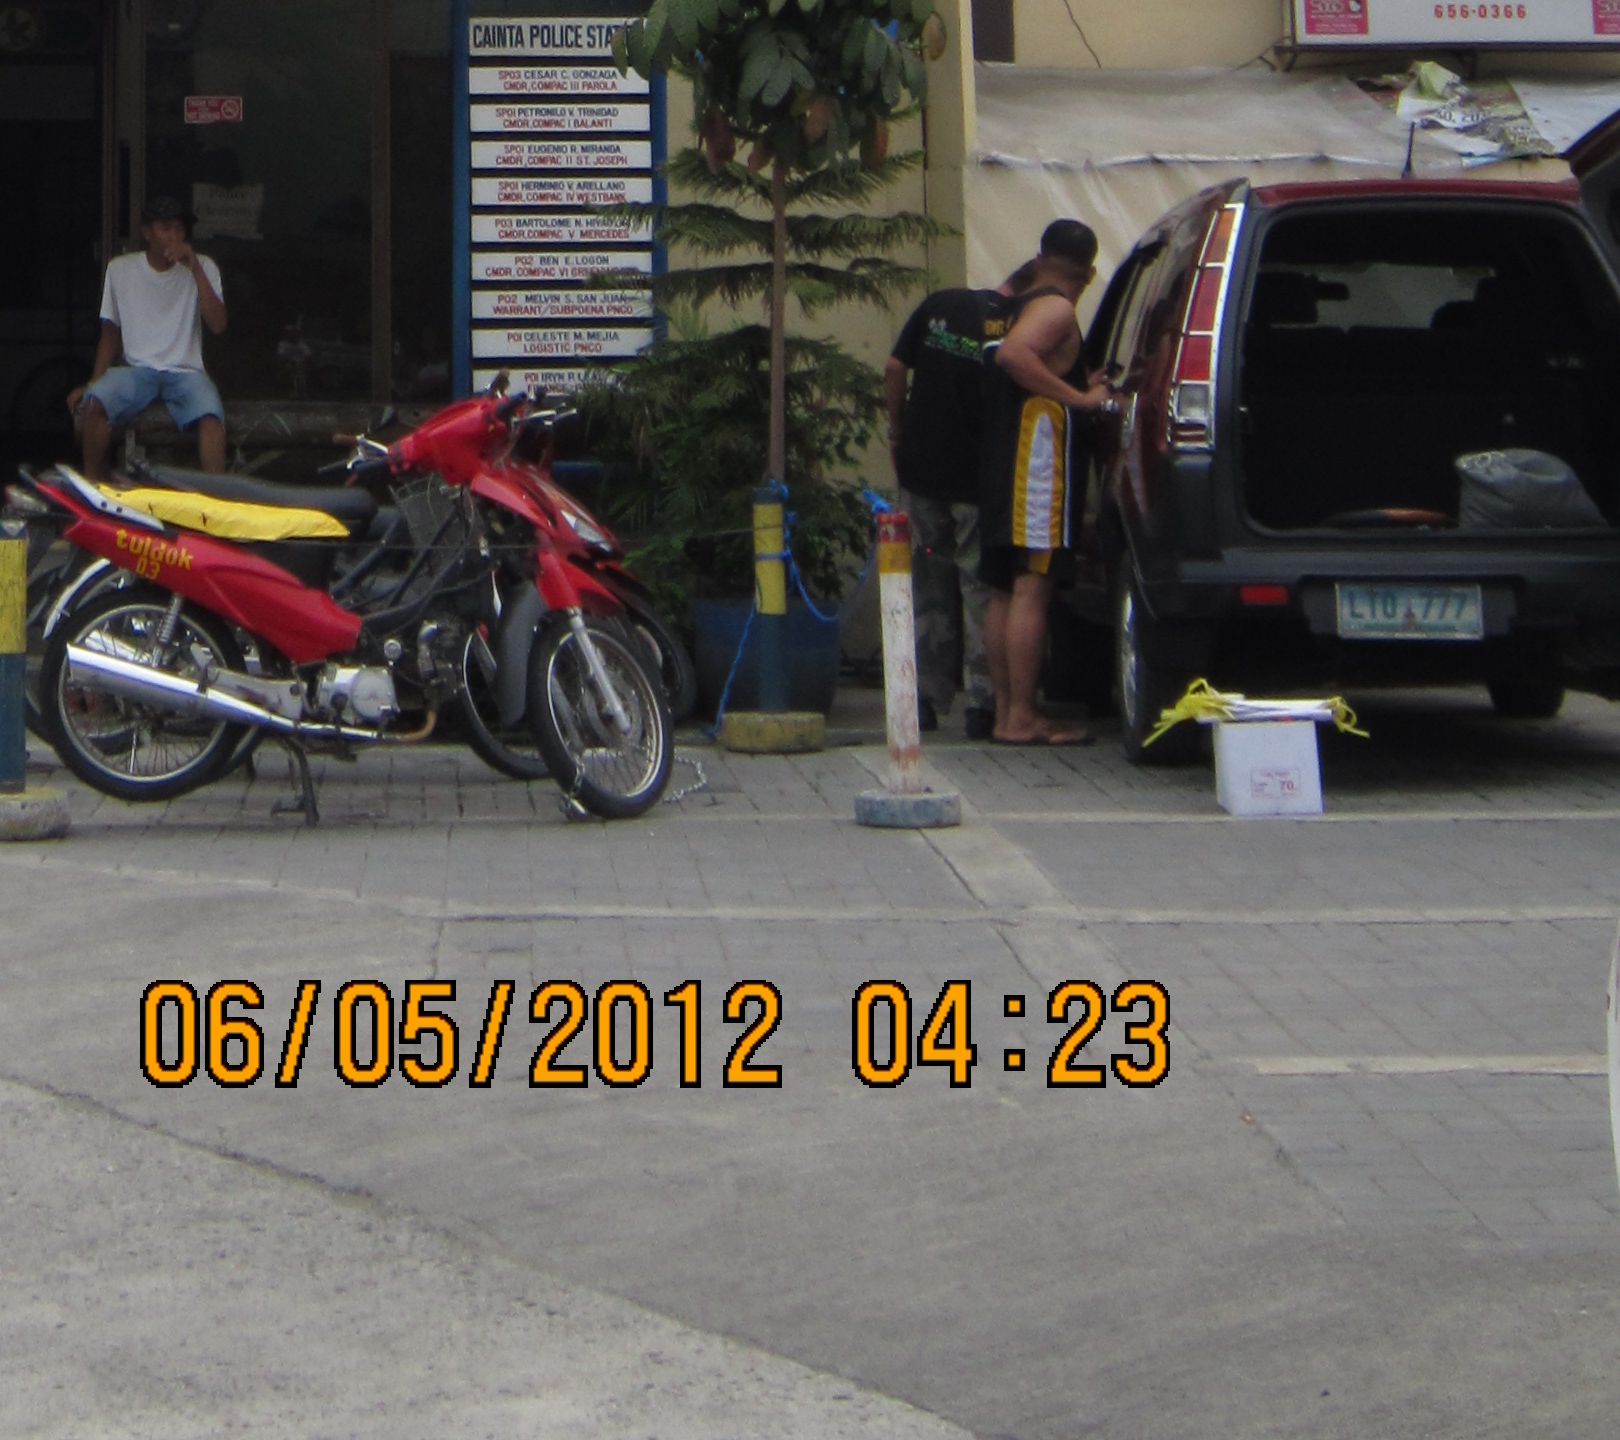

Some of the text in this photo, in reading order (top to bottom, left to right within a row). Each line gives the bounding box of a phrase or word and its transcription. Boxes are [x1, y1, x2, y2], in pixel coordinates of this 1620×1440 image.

[1434, 4, 1527, 20] 656-0366
[473, 24, 524, 49] CAINTA
[529, 24, 583, 48] POLICE
[524, 69, 617, 79] CESAR GONZAGA
[582, 80, 617, 90] PAROLA
[579, 107, 619, 117] TRINIDAD
[528, 144, 621, 154] EUGENIO MIRANDA
[576, 181, 625, 190] ARELLANO
[576, 192, 626, 202] WESTBANK
[580, 229, 629, 239] MERCEDES
[539, 255, 559, 265] BEN
[525, 294, 560, 304] MELVIN
[577, 294, 597, 304] SAN
[524, 331, 619, 341] CELESTE MEJIA
[523, 343, 570, 353] LOGISTIC
[116, 528, 194, 571] tuldok
[1419, 591, 1468, 620] 777
